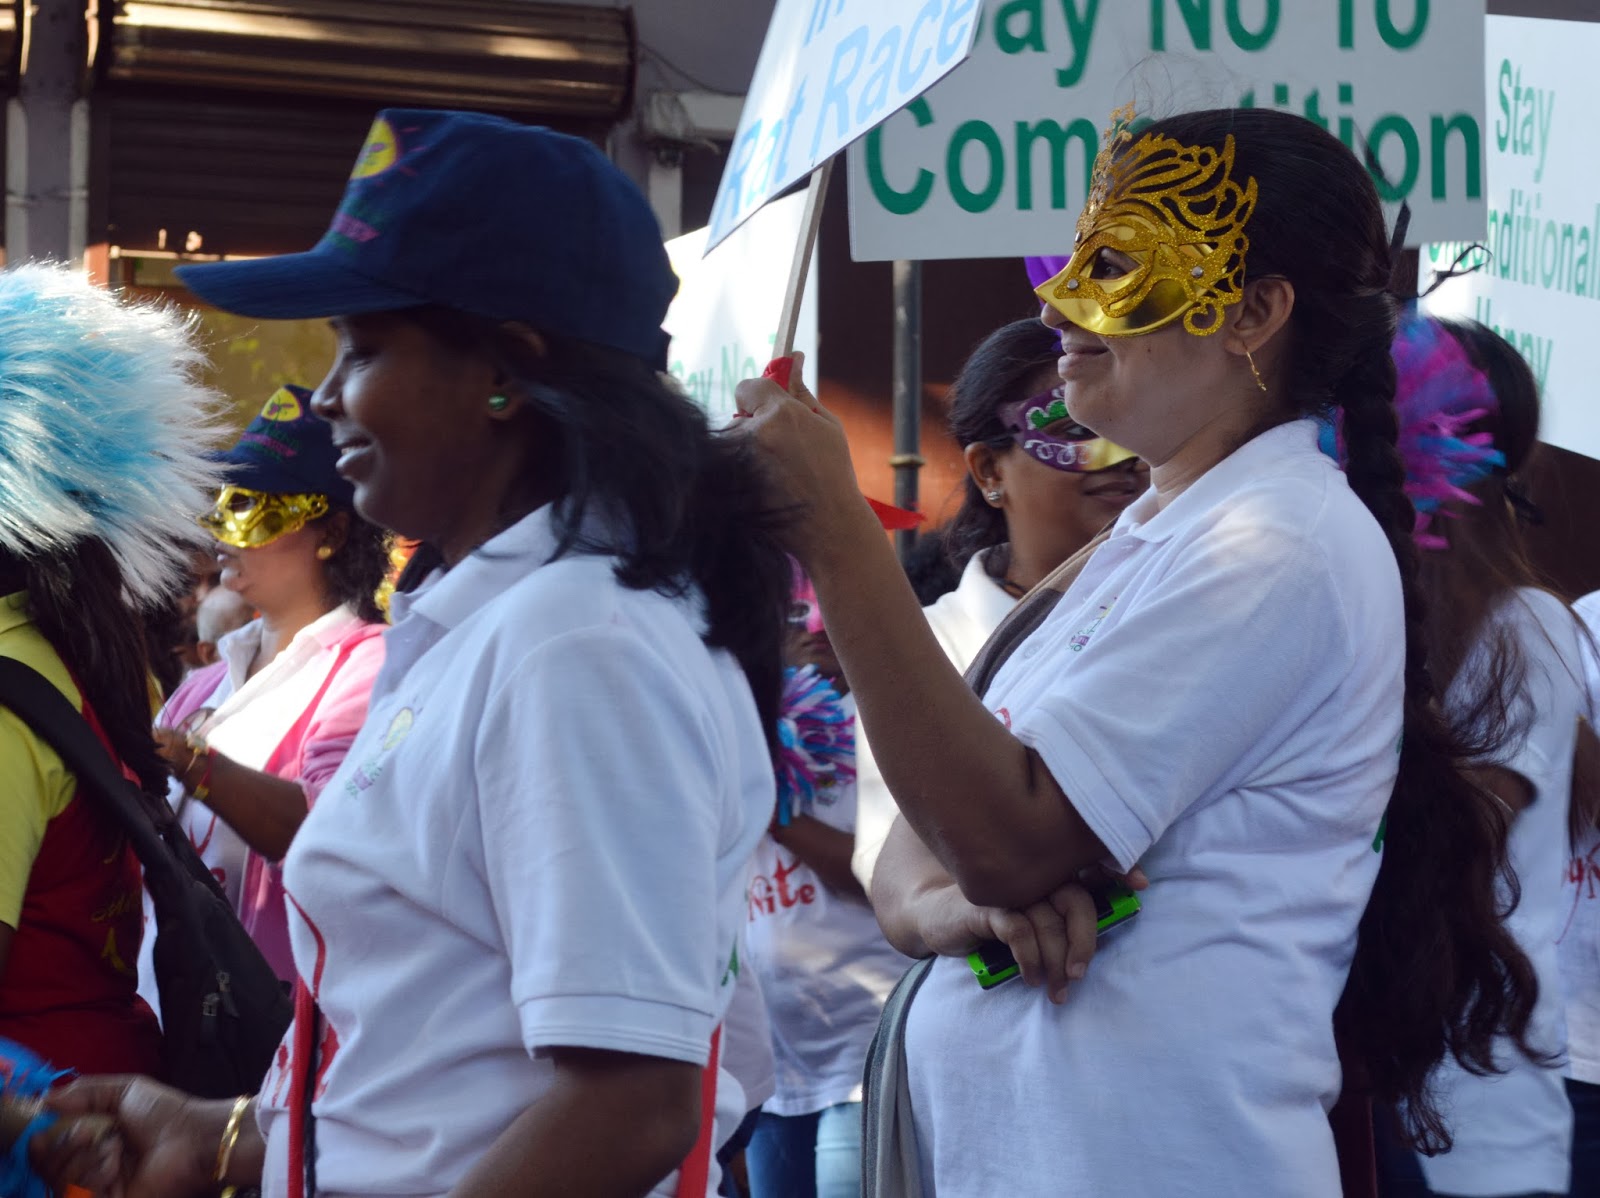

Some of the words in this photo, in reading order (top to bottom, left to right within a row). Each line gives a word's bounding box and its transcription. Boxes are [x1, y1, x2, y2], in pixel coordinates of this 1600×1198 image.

[973, 0, 1098, 88] ay
[711, 75, 808, 238] Rat
[810, 0, 975, 160] Race
[864, 84, 1481, 215] Comion
[1496, 59, 1555, 184] Stay
